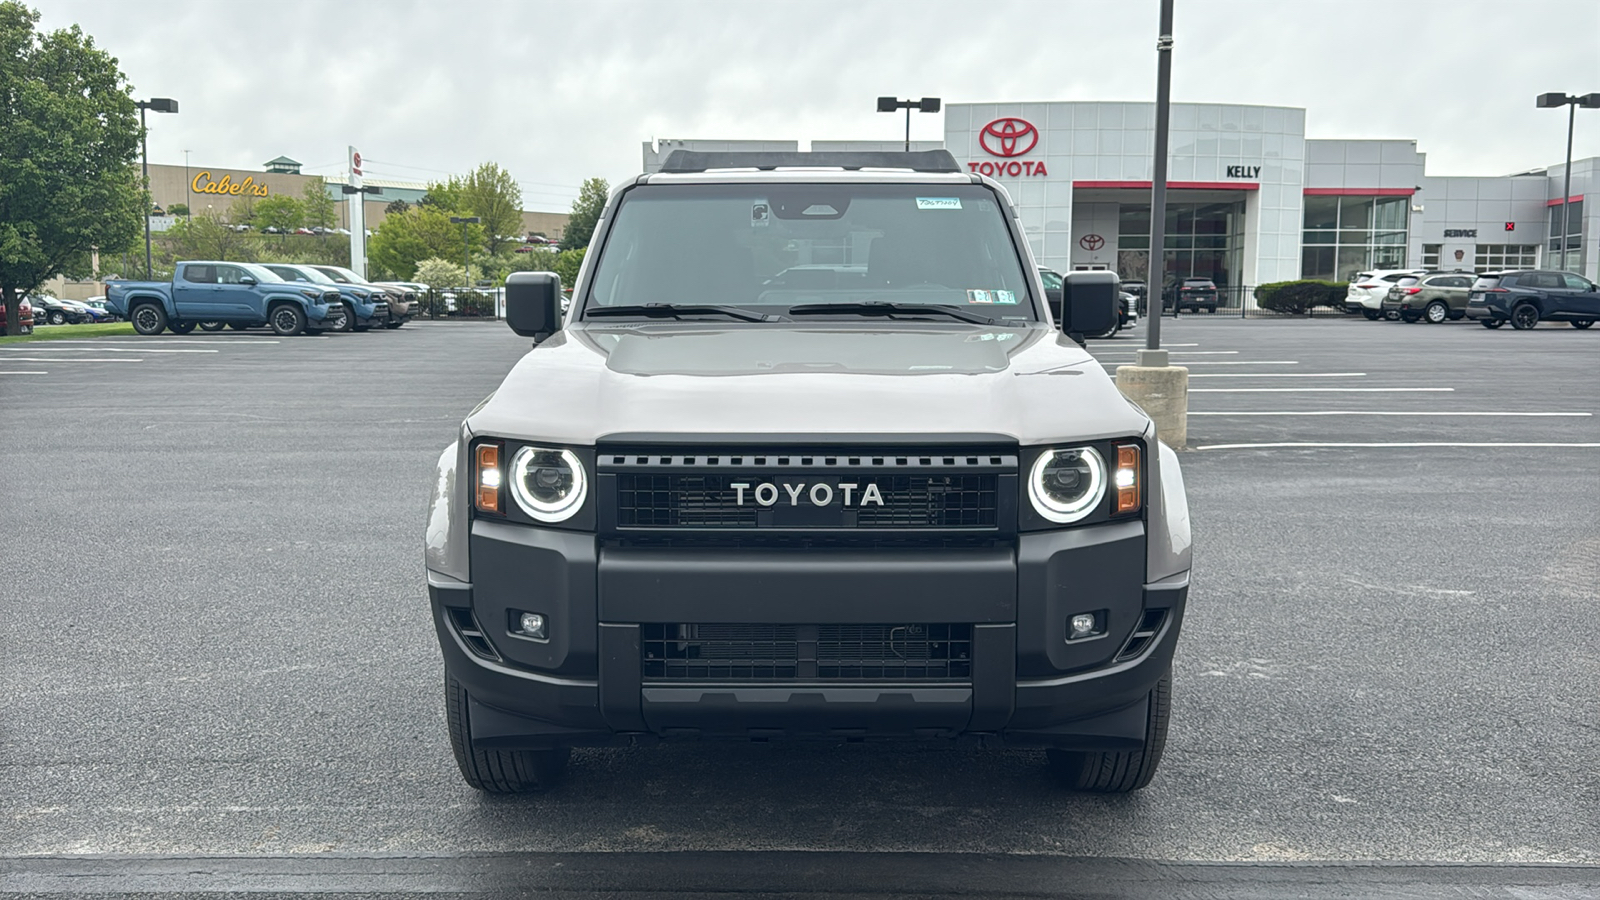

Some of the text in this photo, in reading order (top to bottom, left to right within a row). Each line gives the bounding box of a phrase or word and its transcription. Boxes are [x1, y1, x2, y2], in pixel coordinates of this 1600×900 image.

[967, 160, 1048, 177] TOYOTA
[1226, 165, 1262, 179] KELLY
[191, 171, 268, 197] Cabela's
[1443, 229, 1478, 238] SERVICE
[730, 482, 885, 507] TOYOTA
